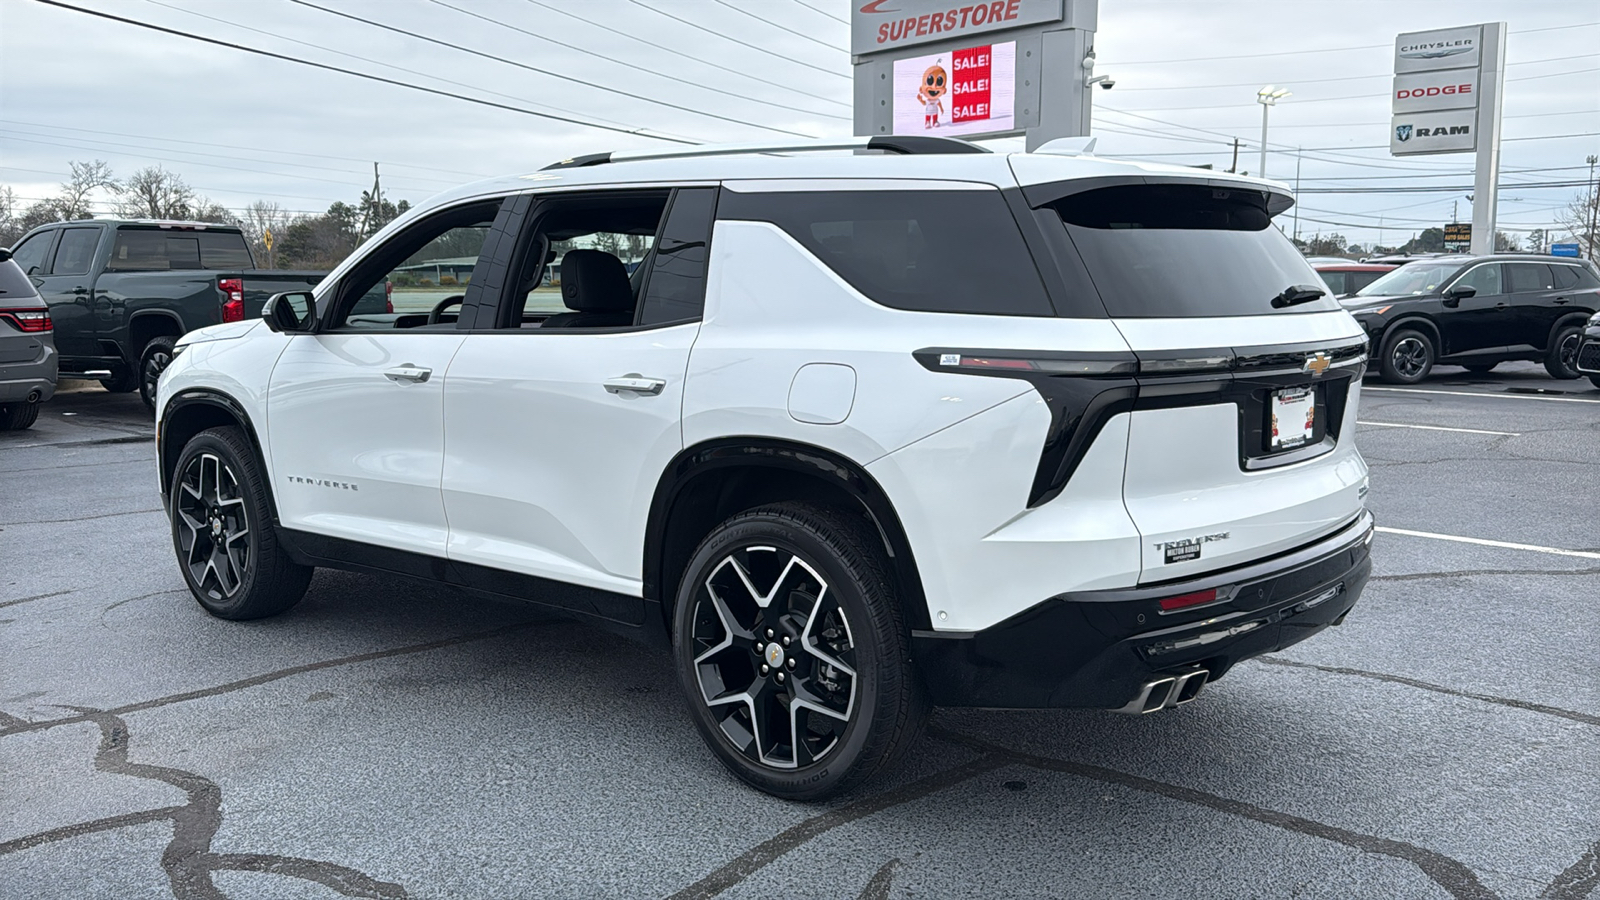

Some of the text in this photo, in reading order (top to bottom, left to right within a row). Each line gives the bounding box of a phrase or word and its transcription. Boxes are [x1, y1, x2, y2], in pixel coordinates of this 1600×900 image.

[877, 0, 1020, 43] SUPERSTORE
[1401, 40, 1472, 52] CHRYSLER
[954, 54, 989, 70] SALE!
[953, 79, 989, 94] SALE!
[1397, 83, 1472, 99] DODGE
[953, 103, 988, 118] SALE!
[1416, 125, 1470, 138] RAM
[287, 475, 358, 491] TRAVERSE
